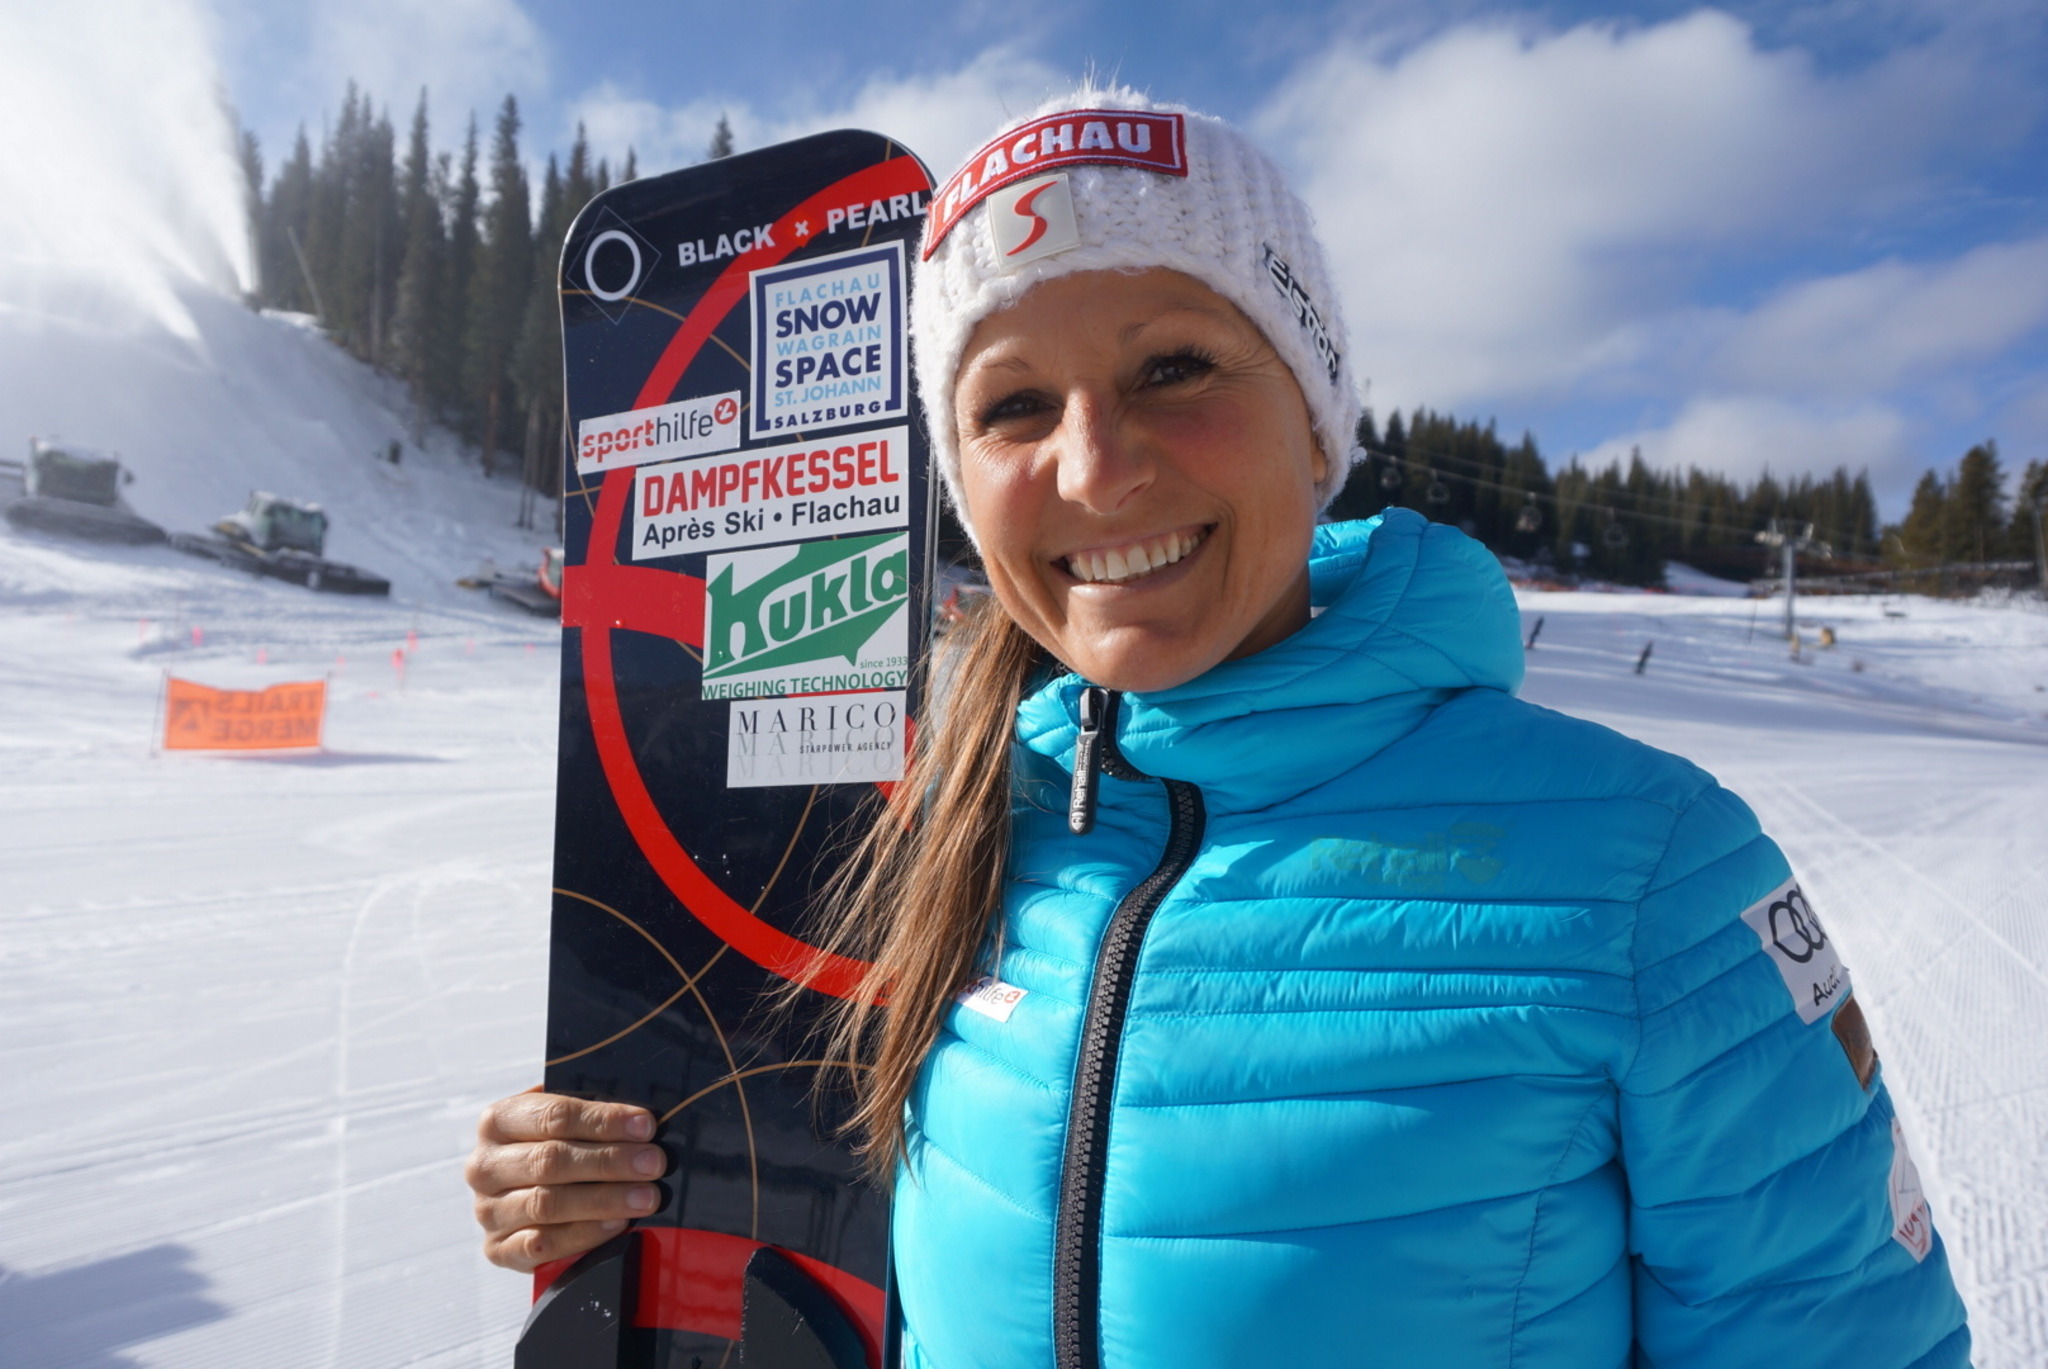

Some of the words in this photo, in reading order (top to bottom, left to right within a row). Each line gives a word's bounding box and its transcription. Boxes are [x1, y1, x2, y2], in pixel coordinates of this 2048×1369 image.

[942, 120, 1151, 218] FLACHAU
[678, 223, 775, 267] BLACK
[827, 191, 928, 234] PEARL
[775, 272, 880, 308] FLACHAU
[775, 292, 881, 338] SNOW
[776, 324, 881, 357] WAGRAIN
[775, 343, 881, 388] SPACE
[774, 390, 797, 407] ST.
[800, 375, 881, 403] JOHANN
[774, 401, 881, 429] SALZBURG
[582, 410, 713, 463] sporthilfe
[643, 440, 899, 517] DAMPFKESSEL
[642, 517, 715, 549] Après
[724, 508, 764, 535] Ski
[791, 495, 900, 526] Flachau
[860, 659, 885, 669] since
[886, 656, 908, 668] 1933
[702, 679, 786, 699] WEIGHING
[790, 670, 908, 694] TECHNOLOGY
[736, 701, 896, 735] MARICO
[799, 742, 853, 754] STARPOWER
[857, 741, 891, 751] AGENCY
